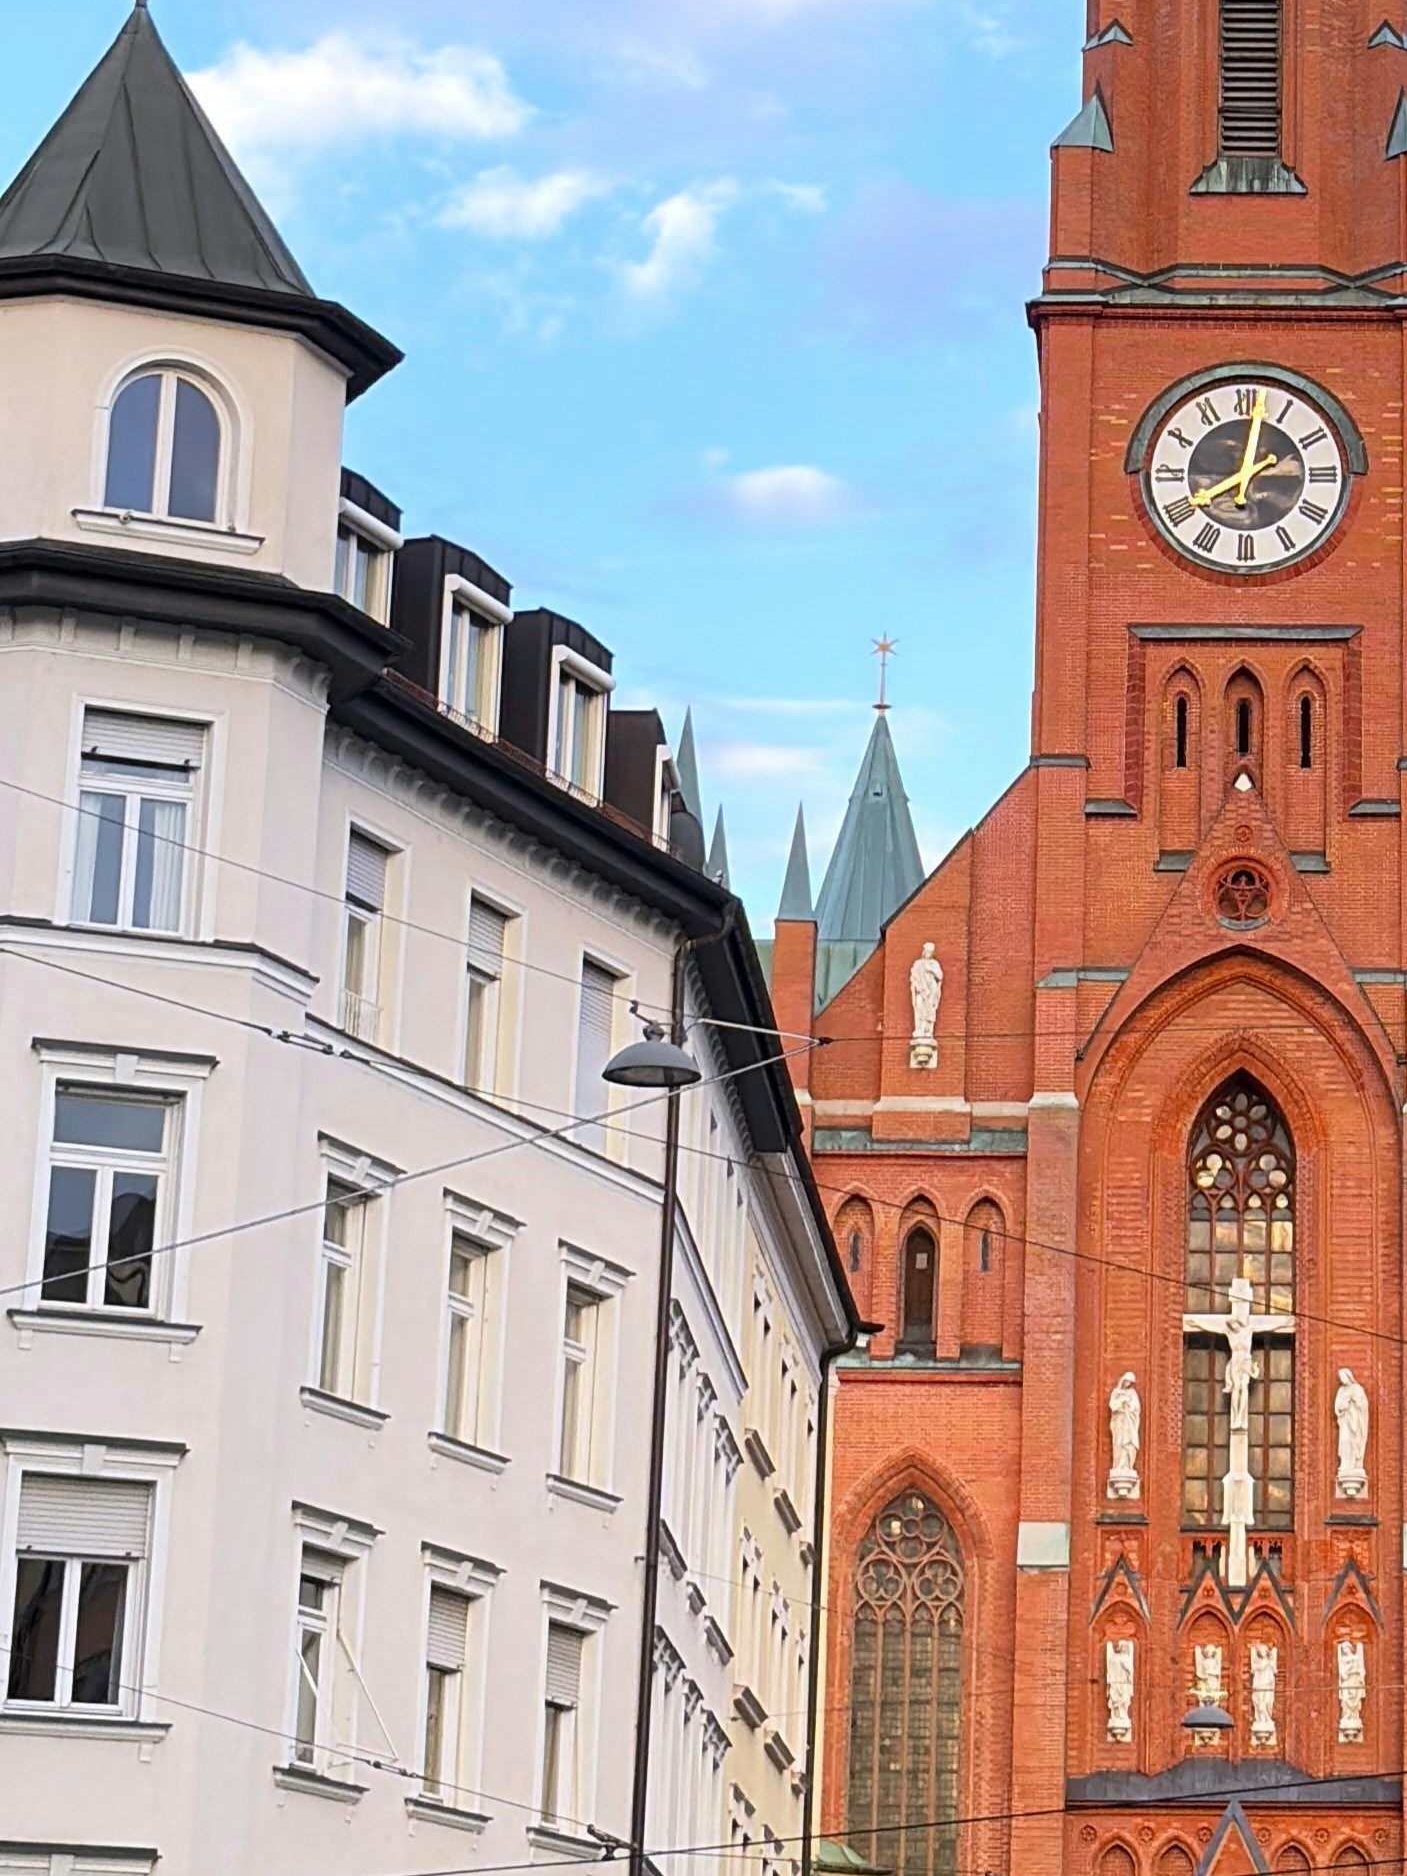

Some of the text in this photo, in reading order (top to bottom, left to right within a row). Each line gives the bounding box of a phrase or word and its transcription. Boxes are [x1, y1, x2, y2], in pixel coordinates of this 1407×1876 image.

[1195, 396, 1222, 427] XI
[1167, 427, 1194, 449] X
[1298, 426, 1328, 451] II
[1155, 464, 1185, 483] IX
[1308, 465, 1337, 484] III
